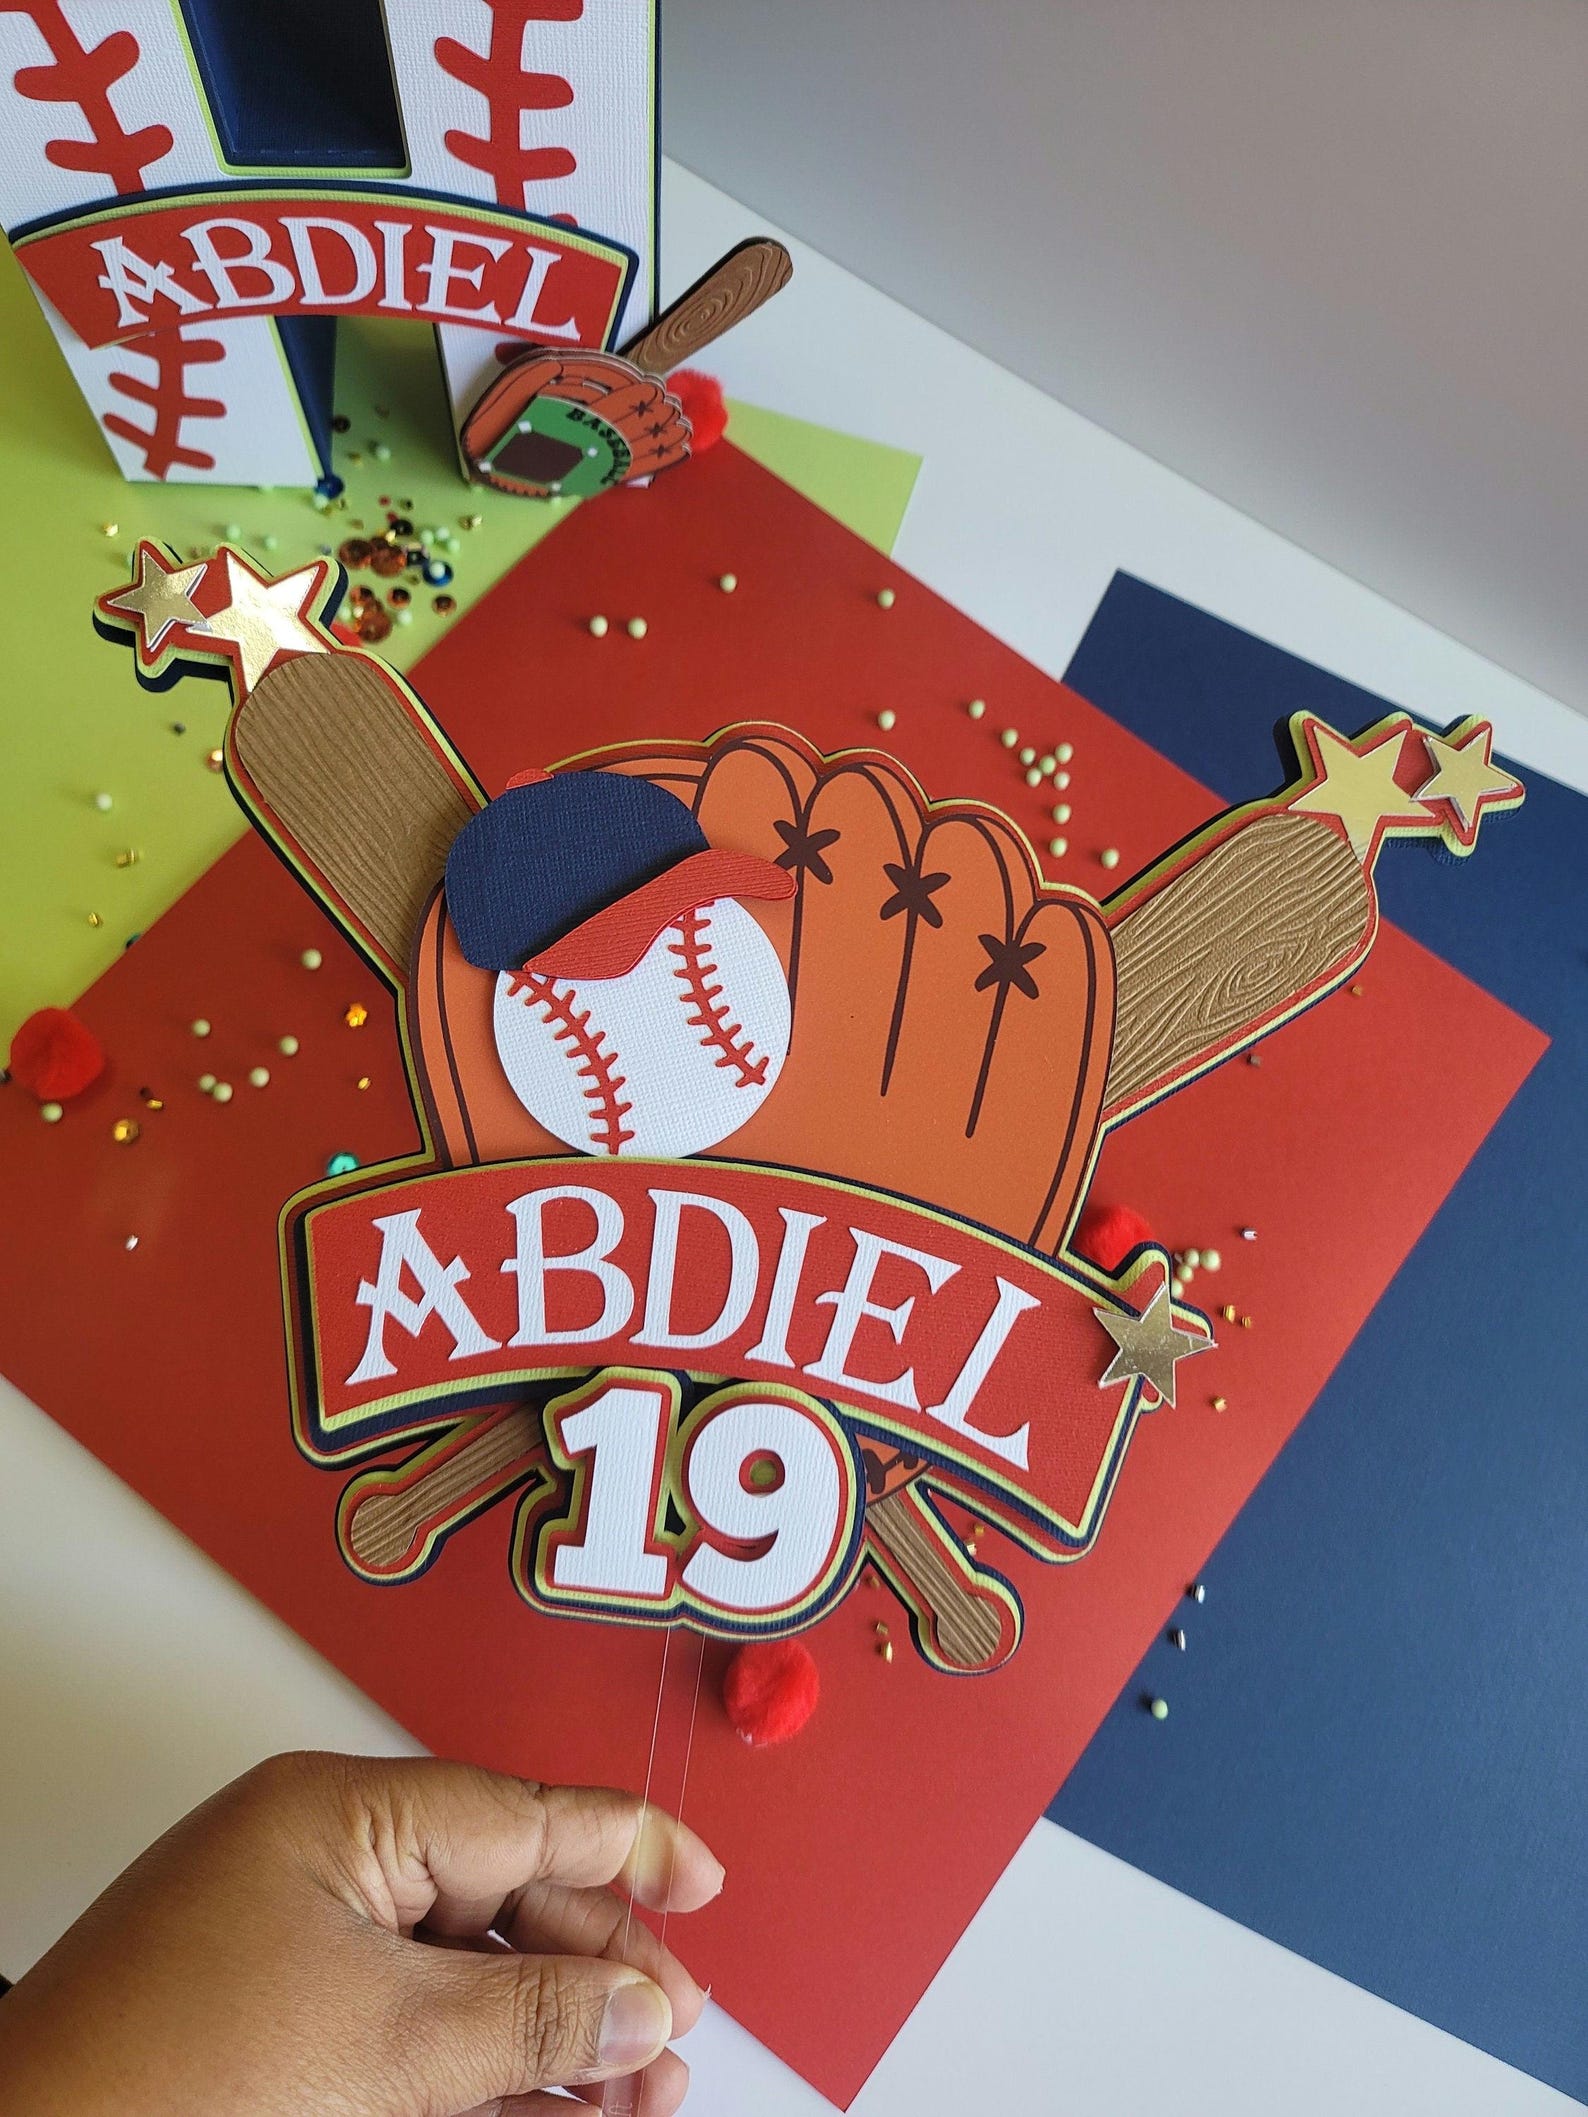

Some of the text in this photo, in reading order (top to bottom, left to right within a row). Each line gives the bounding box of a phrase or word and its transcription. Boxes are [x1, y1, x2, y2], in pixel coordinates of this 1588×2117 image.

[91, 217, 580, 340] ABDIEL
[346, 1186, 1041, 1471] ABDIEL
[554, 1388, 840, 1609] 19
